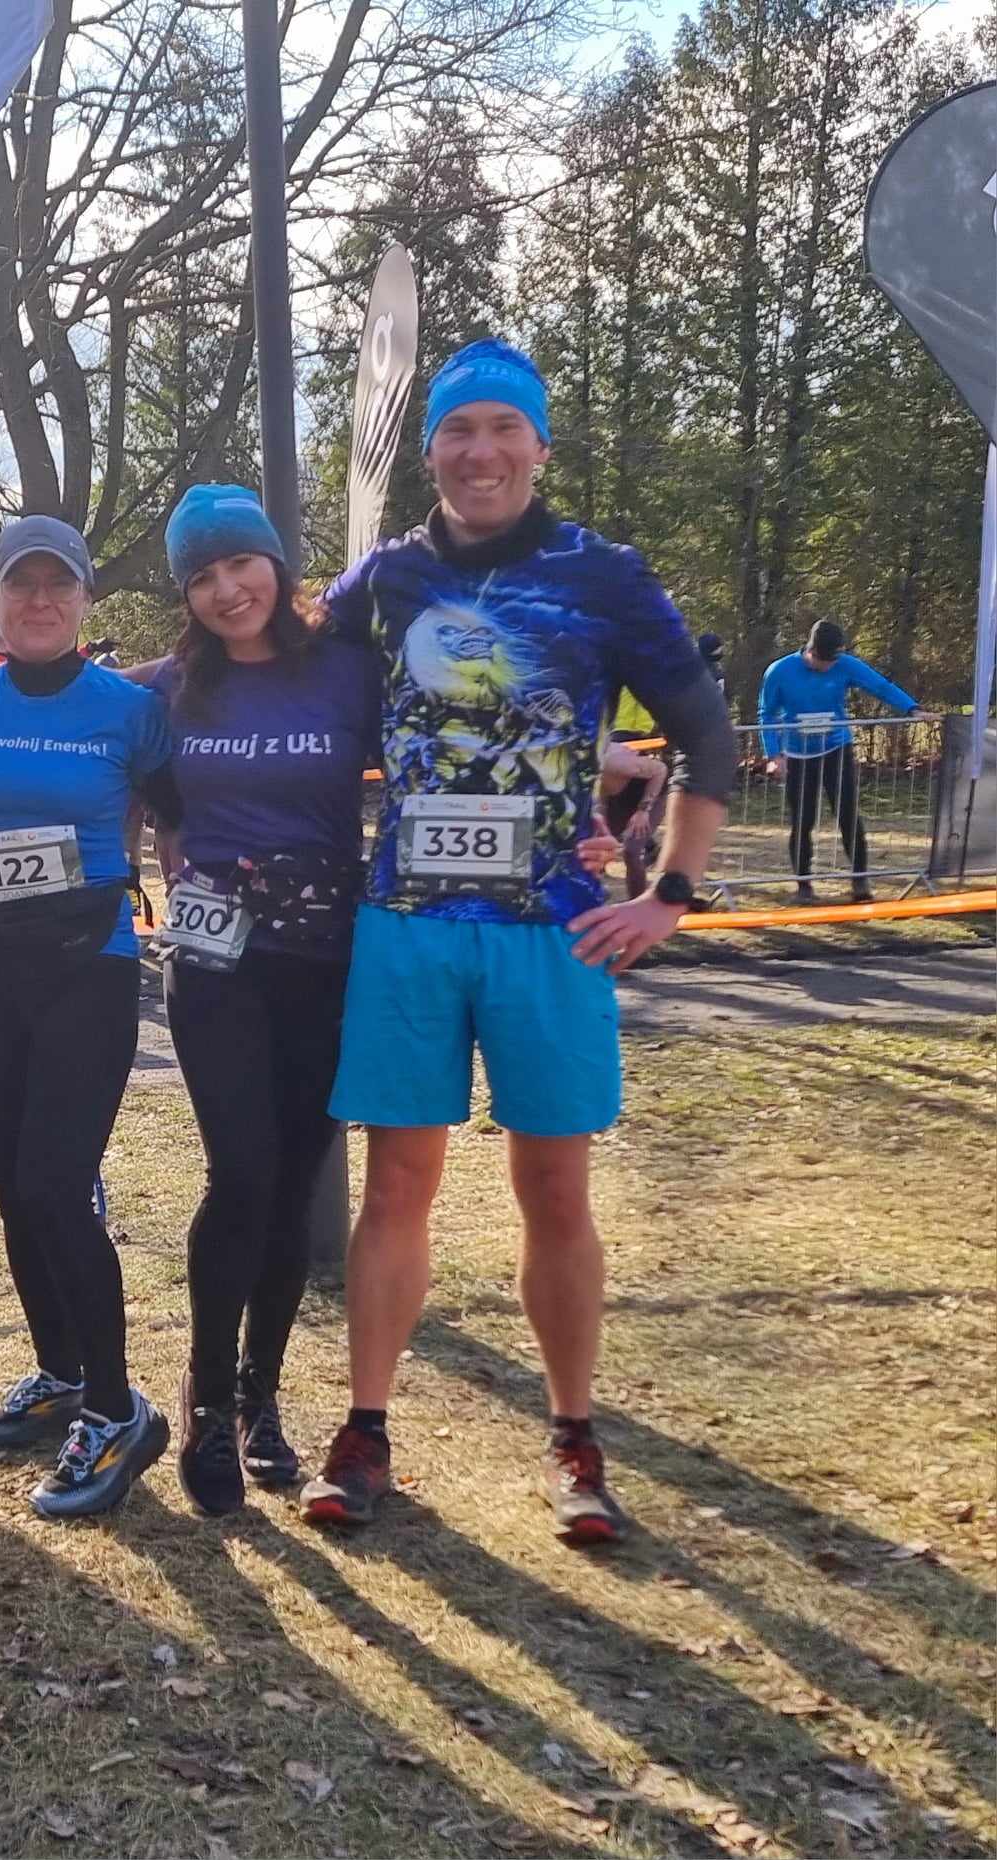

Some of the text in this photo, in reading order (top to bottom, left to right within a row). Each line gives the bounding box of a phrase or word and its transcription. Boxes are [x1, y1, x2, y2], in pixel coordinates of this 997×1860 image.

[182, 733, 332, 759] Trenuj z UŁ!
[423, 826, 498, 858] 338
[172, 901, 228, 936] 300
